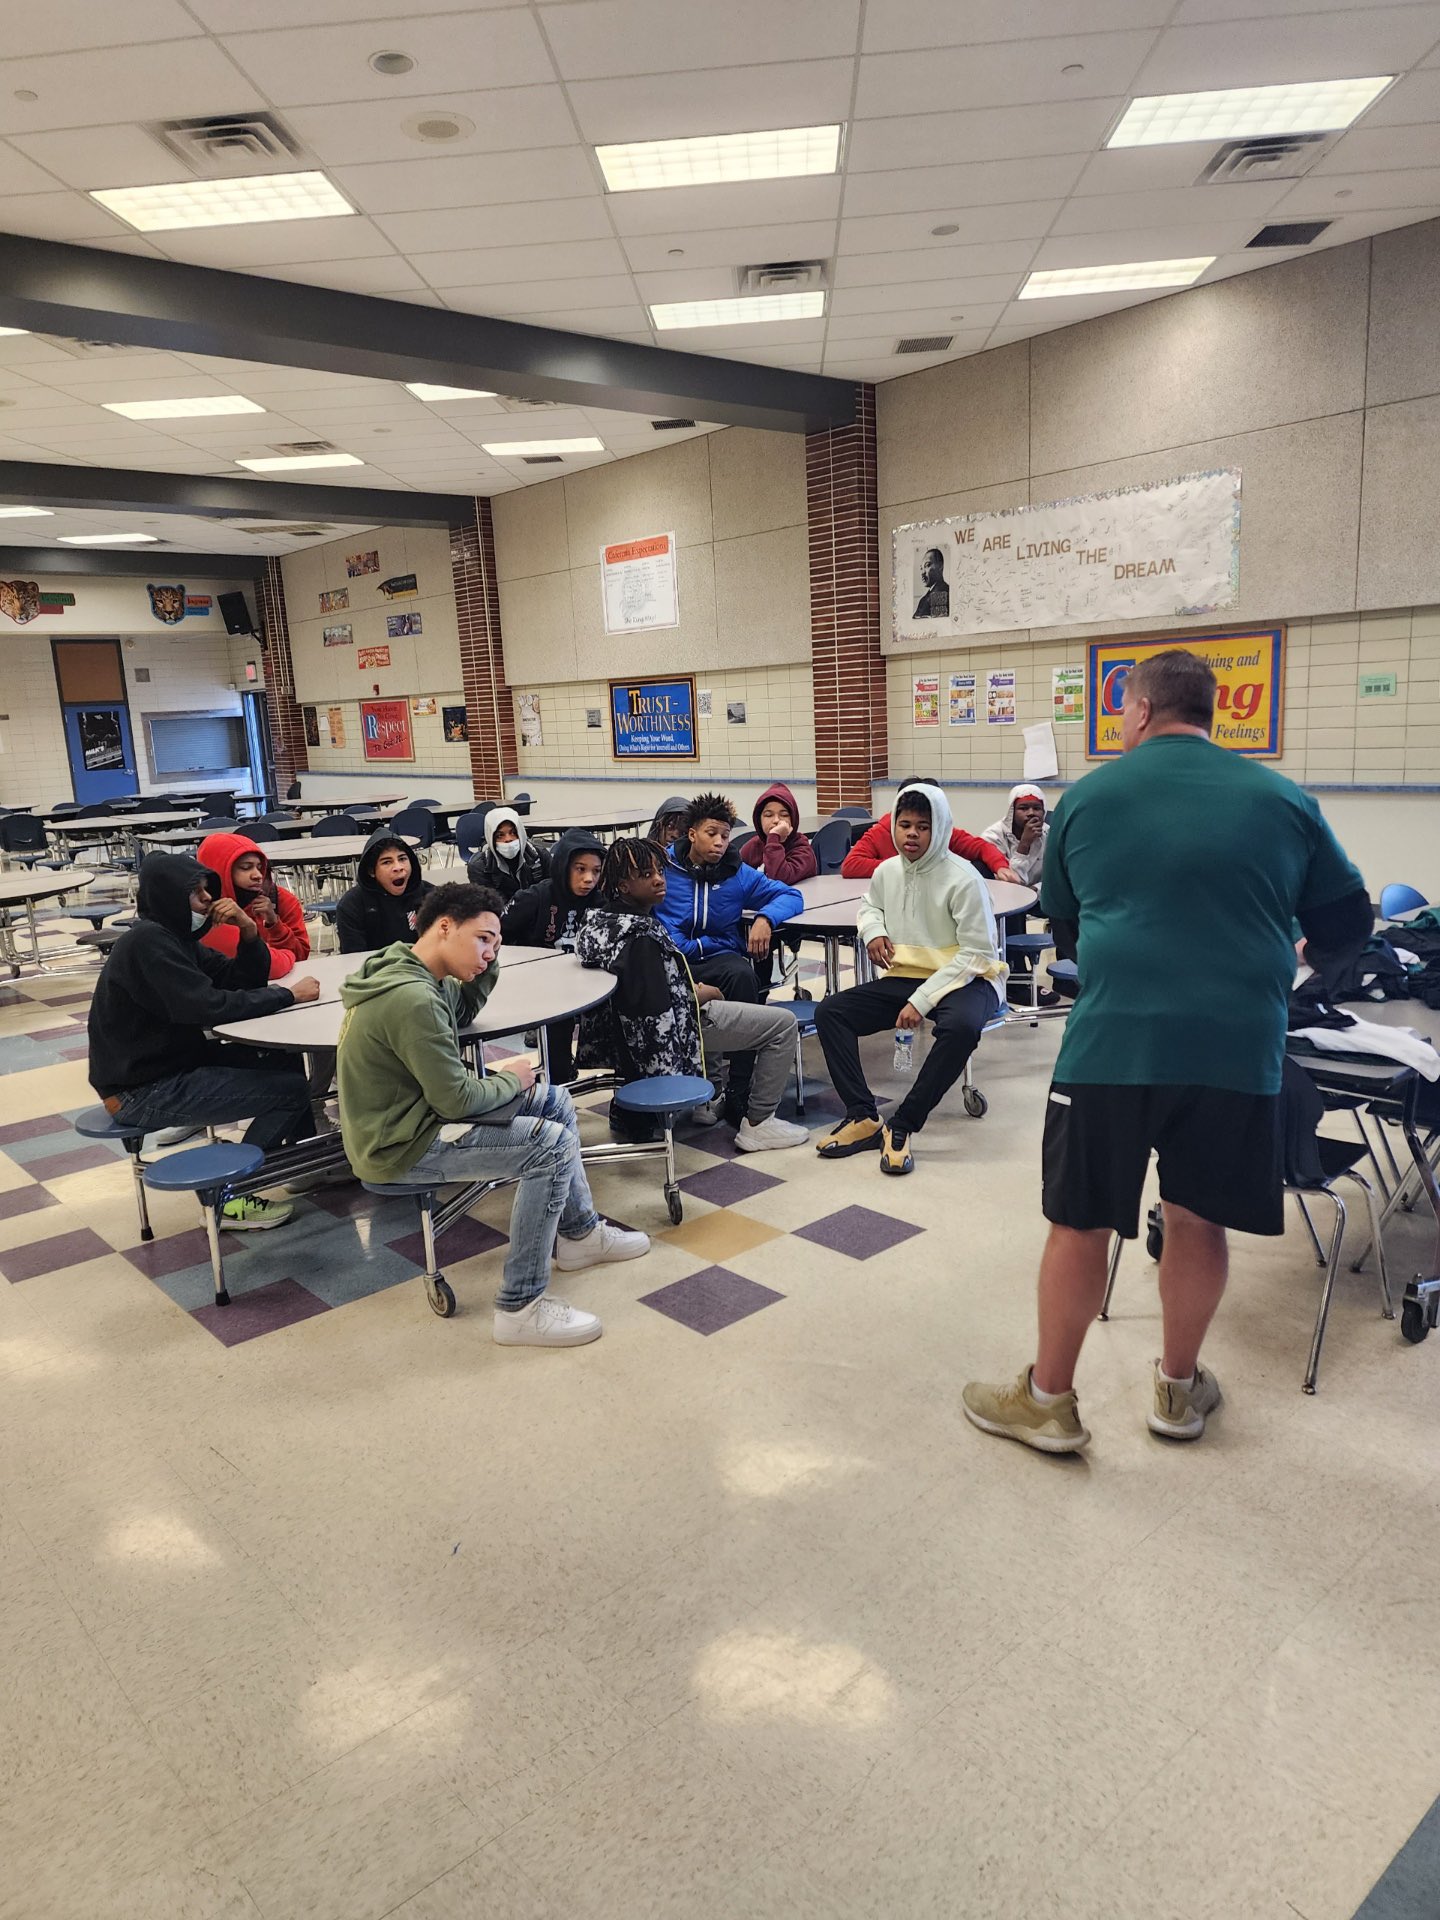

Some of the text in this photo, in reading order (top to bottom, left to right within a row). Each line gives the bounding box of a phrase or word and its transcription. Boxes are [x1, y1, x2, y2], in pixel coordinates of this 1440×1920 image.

[954, 528, 1177, 580] WE ARE LIVING THE DREAM
[1236, 650, 1261, 667] and
[366, 714, 406, 739] Respect
[616, 712, 691, 735] WORTHINESS
[1215, 723, 1266, 743] Feelings
[630, 734, 649, 744] Keeping
[650, 734, 661, 742] Your
